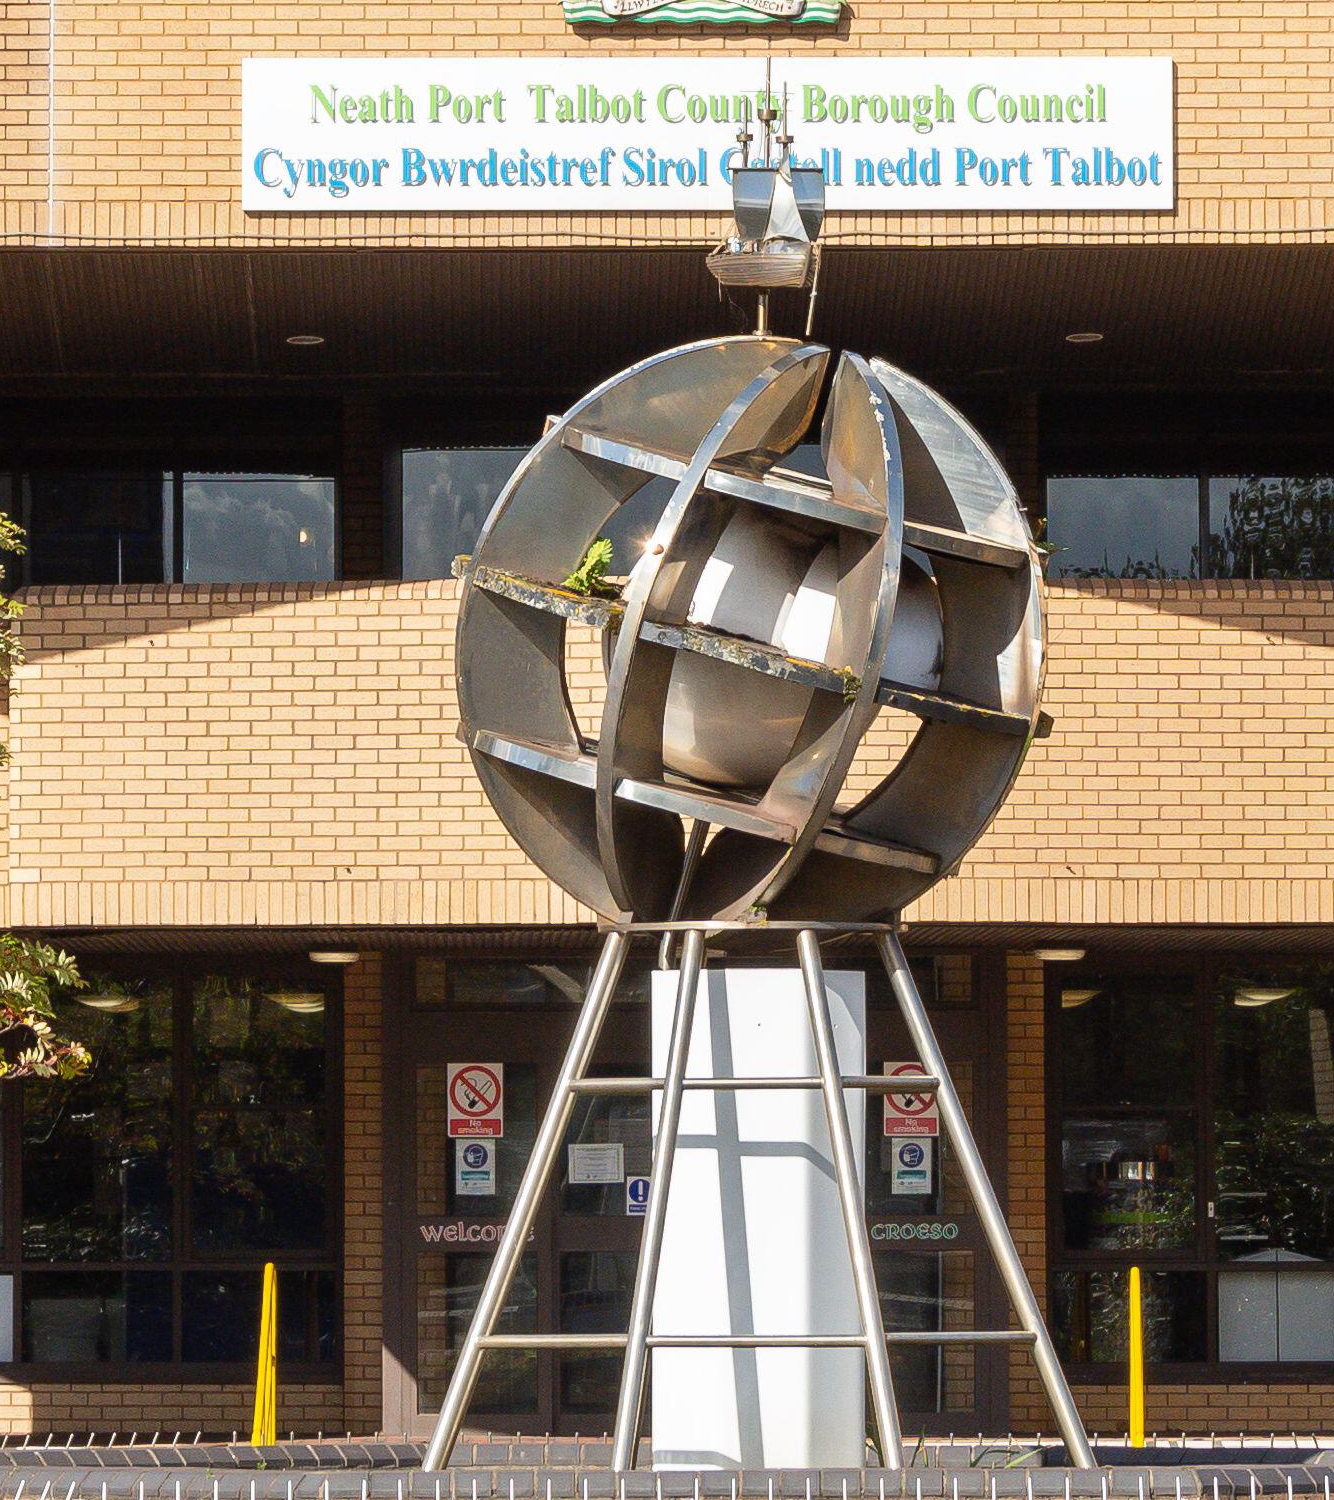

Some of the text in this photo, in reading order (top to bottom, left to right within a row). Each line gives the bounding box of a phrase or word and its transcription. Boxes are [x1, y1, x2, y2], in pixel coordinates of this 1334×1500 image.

[309, 83, 414, 124] Neath
[428, 83, 507, 124] Port
[527, 83, 647, 124] Talbot
[801, 83, 955, 134] Borough
[967, 83, 1108, 124] Council
[253, 146, 390, 198] Cyngor
[400, 146, 616, 188] Bwrdeistref
[622, 146, 709, 188] Sirol
[853, 146, 944, 187] nedd
[954, 146, 1033, 187] Port
[1042, 146, 1163, 187] Talbot
[457, 1126, 494, 1136] smoking
[469, 1119, 482, 1127] No
